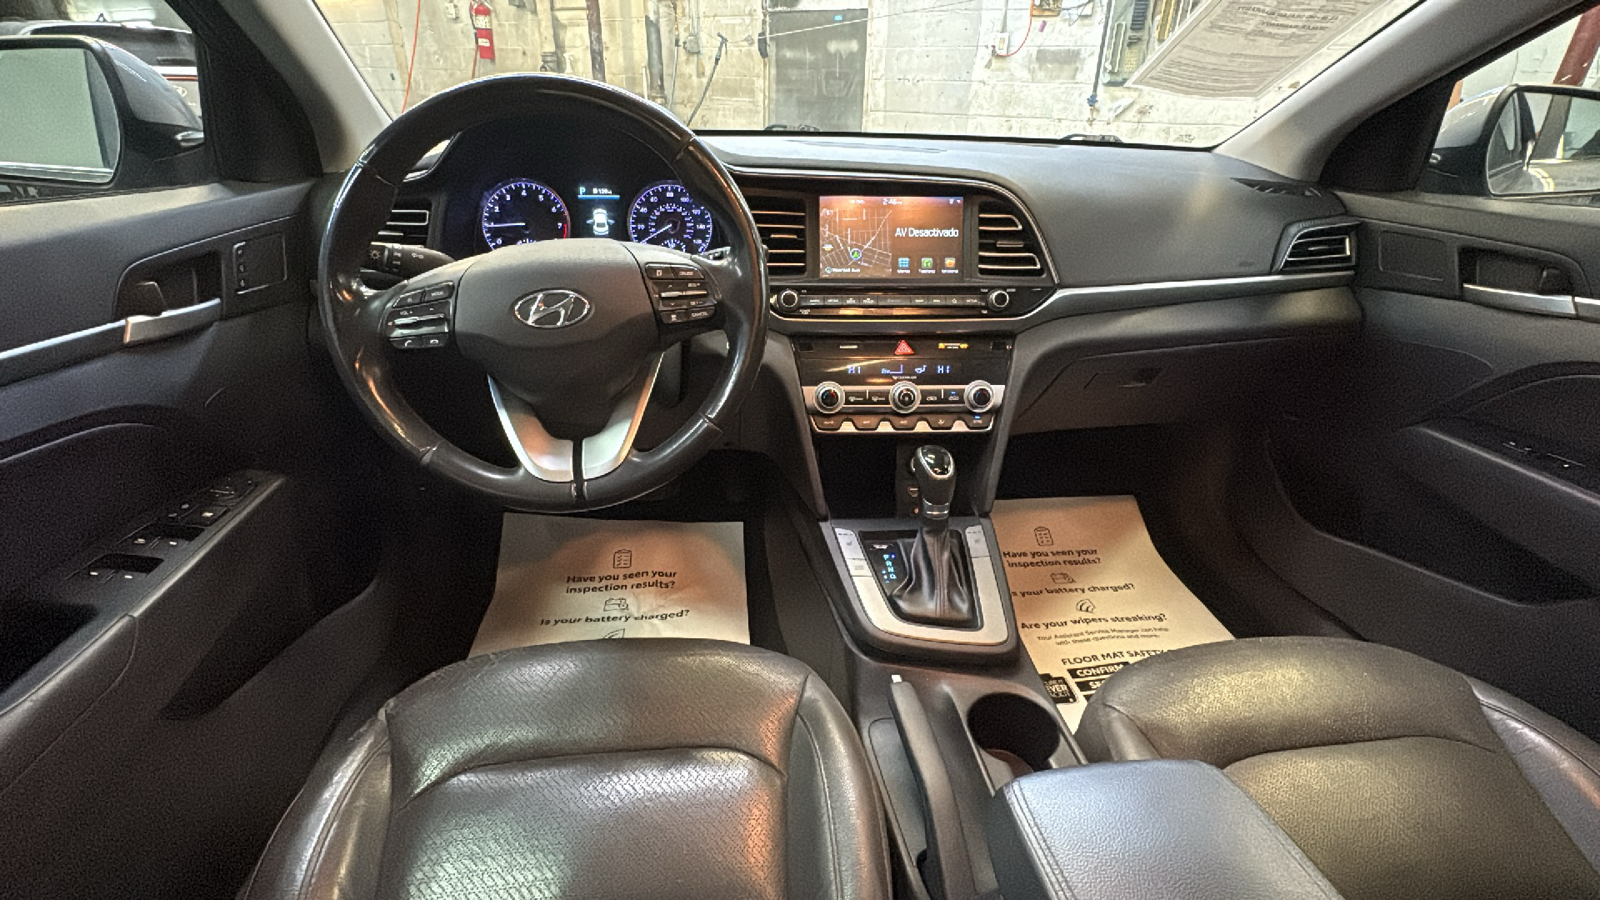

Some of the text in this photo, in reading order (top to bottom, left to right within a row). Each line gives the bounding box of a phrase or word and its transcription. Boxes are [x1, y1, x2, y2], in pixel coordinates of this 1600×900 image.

[580, 187, 586, 195] P
[895, 227, 959, 237] AV Desactivado
[1030, 550, 1049, 558] you
[1051, 549, 1074, 557] seen
[1075, 548, 1097, 557] your
[1007, 557, 1101, 568] inspection results?
[566, 570, 678, 583] Have you seen your
[566, 580, 676, 594] inspection results?
[1020, 589, 1043, 597] your
[1045, 587, 1085, 596] battery
[1087, 583, 1136, 592] charged?
[553, 617, 582, 626] your
[585, 614, 631, 623] battery
[634, 610, 690, 621] charged?
[1021, 612, 1168, 630] Are your wipers streaking?
[1061, 655, 1098, 666] FLOOR
[1101, 651, 1124, 661] MAT
[1076, 664, 1124, 677] CONFIRM
